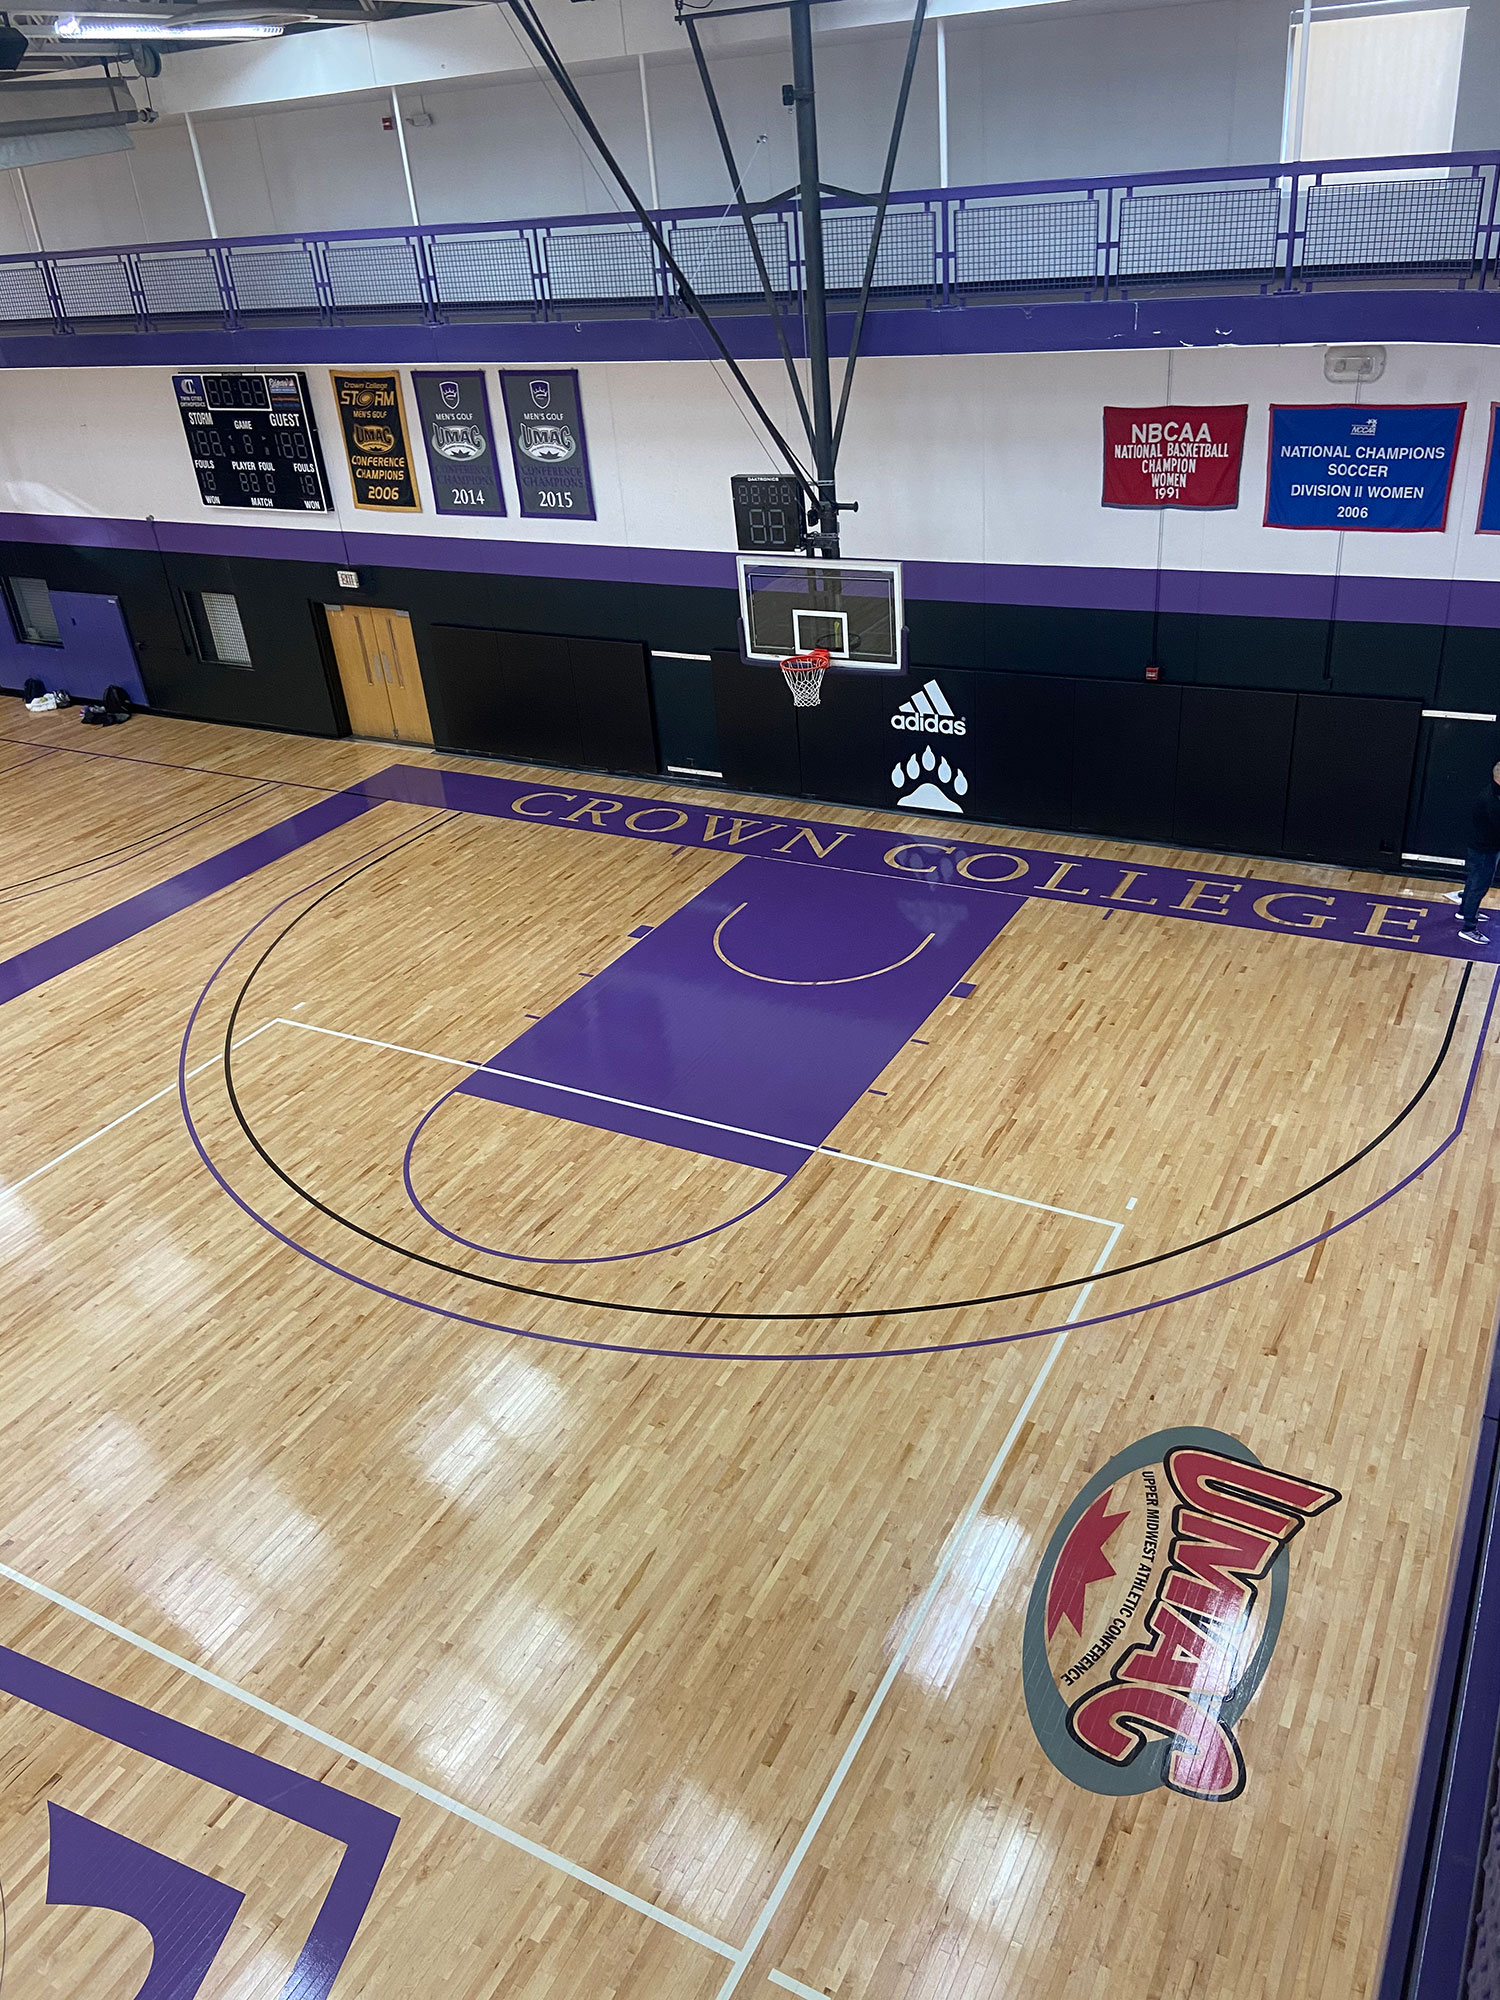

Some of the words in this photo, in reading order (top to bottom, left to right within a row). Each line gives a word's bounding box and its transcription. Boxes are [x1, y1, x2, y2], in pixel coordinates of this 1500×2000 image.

[188, 412, 214, 425] STORM
[234, 420, 252, 430] GAME
[269, 413, 300, 427] GUEST
[353, 424, 393, 443] UMAC
[432, 422, 480, 448] UMAC
[520, 422, 571, 450] UMAC
[1132, 421, 1211, 443] NBCAA
[1351, 425, 1376, 434] NCCAA
[1114, 444, 1162, 459] NATIONAL
[1167, 443, 1229, 458] BASKETBALL
[1280, 445, 1351, 458] NATIONAL
[1356, 447, 1445, 460] CHAMPIONS
[195, 460, 214, 469] FOULS
[232, 461, 256, 470] PLAYER
[259, 462, 275, 471] FOUL
[293, 463, 315, 472] FOULS
[352, 455, 405, 467] CONFERENCE
[1142, 458, 1196, 474] CHAMPION
[356, 468, 404, 480] CHAMPIONS
[521, 465, 582, 477] CONFERENCE
[1328, 464, 1388, 478] SOCCER
[522, 476, 584, 488] CHAMPIONS
[1152, 473, 1186, 488] WOMEN
[368, 486, 399, 500] 2006
[452, 488, 485, 504] 2014
[1155, 487, 1179, 499] 1991
[1290, 484, 1350, 498] DIVISION
[1354, 486, 1363, 497] II
[1368, 486, 1424, 498] WOMEN
[205, 496, 220, 504] WON
[251, 498, 273, 506] MATCH
[304, 501, 320, 509] WON
[538, 491, 573, 508] 2015
[1337, 507, 1368, 518] 2006
[891, 712, 966, 735] adidas
[510, 792, 856, 859] CROWN
[882, 843, 1429, 944] COLLEGE
[1142, 1471, 1159, 1507] UPPER
[1141, 1508, 1159, 1562] MIDWEST
[1119, 1562, 1152, 1618] ATHLETIC
[1065, 1445, 1342, 1802] UMAC
[1060, 1618, 1126, 1687] CONFERENCE
